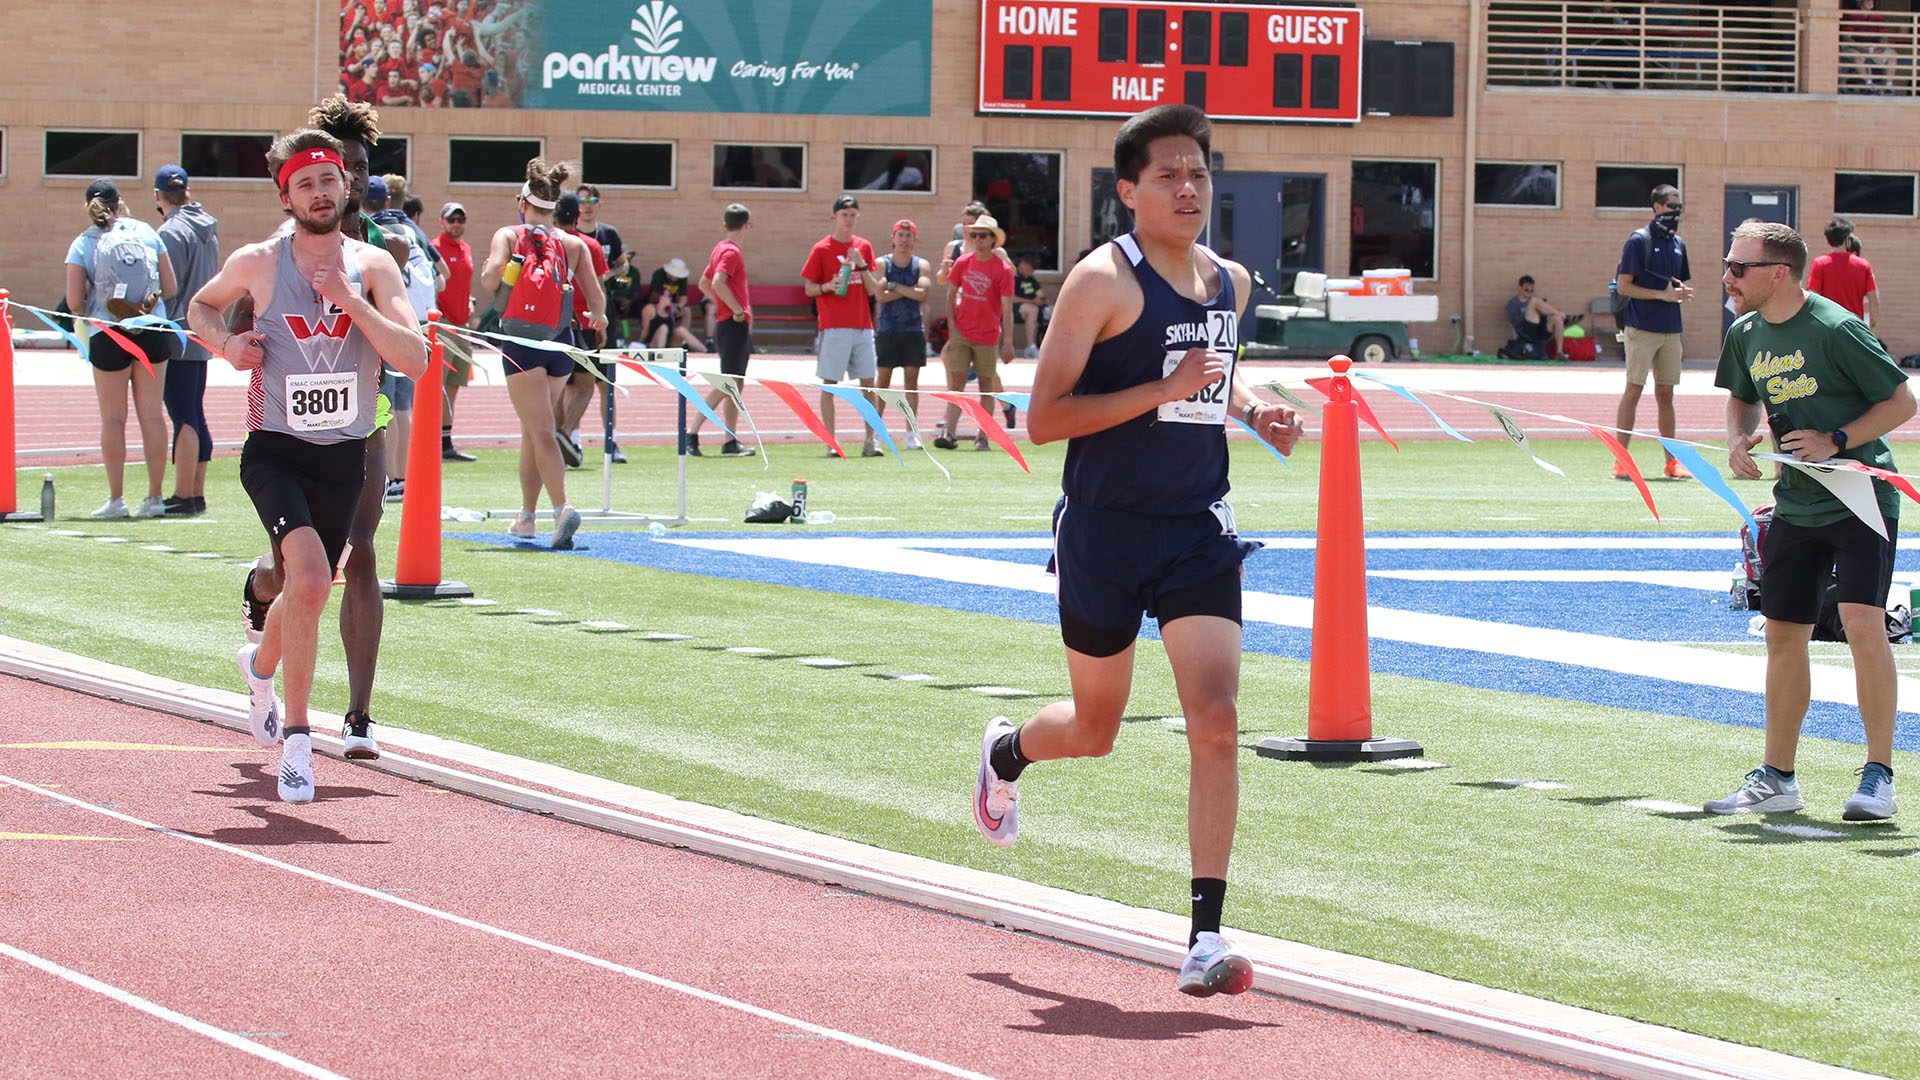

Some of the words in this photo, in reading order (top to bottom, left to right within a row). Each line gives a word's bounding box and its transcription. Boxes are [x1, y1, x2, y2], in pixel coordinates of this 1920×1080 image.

[998, 6, 1078, 36] HOME
[1267, 14, 1348, 45] GUEST
[543, 45, 717, 89] parkview
[730, 60, 787, 86] Caring
[791, 61, 821, 79] For
[578, 82, 632, 95] MEDICAL
[636, 84, 681, 96] CENTER
[1112, 77, 1165, 102] HALF
[1165, 322, 1209, 346] SKYHA
[1213, 313, 1236, 348] 20
[1750, 349, 1804, 381] Adams
[292, 387, 349, 416] 3801
[1766, 373, 1819, 404] State
